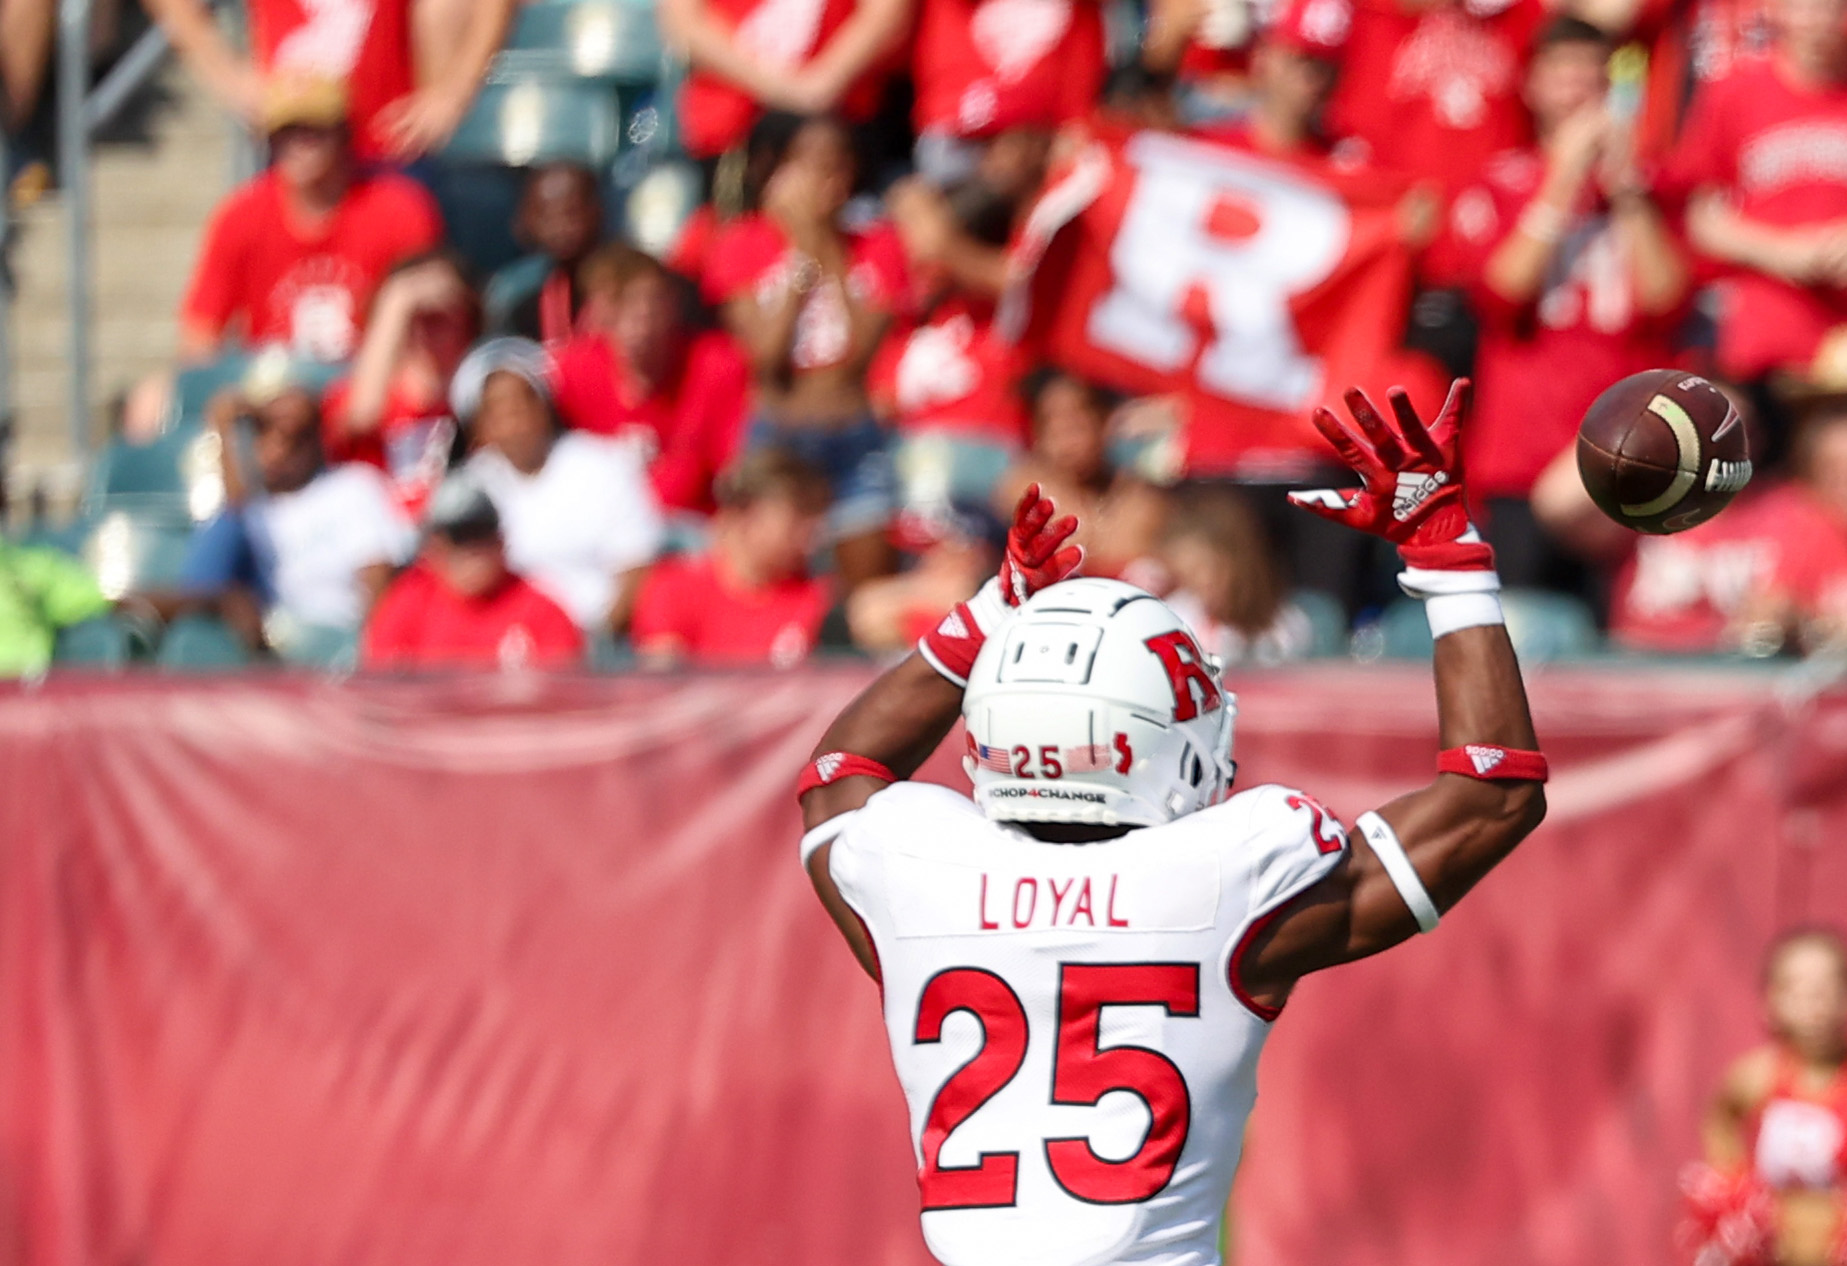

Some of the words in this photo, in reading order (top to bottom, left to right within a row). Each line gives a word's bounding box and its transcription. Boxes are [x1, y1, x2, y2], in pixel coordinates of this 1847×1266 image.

[1087, 129, 1349, 411] R
[1393, 470, 1449, 522] adidas
[1142, 629, 1221, 723] R
[1012, 744, 1063, 779] 25
[979, 873, 1129, 930] LOYAL
[913, 960, 1201, 1212] 25
